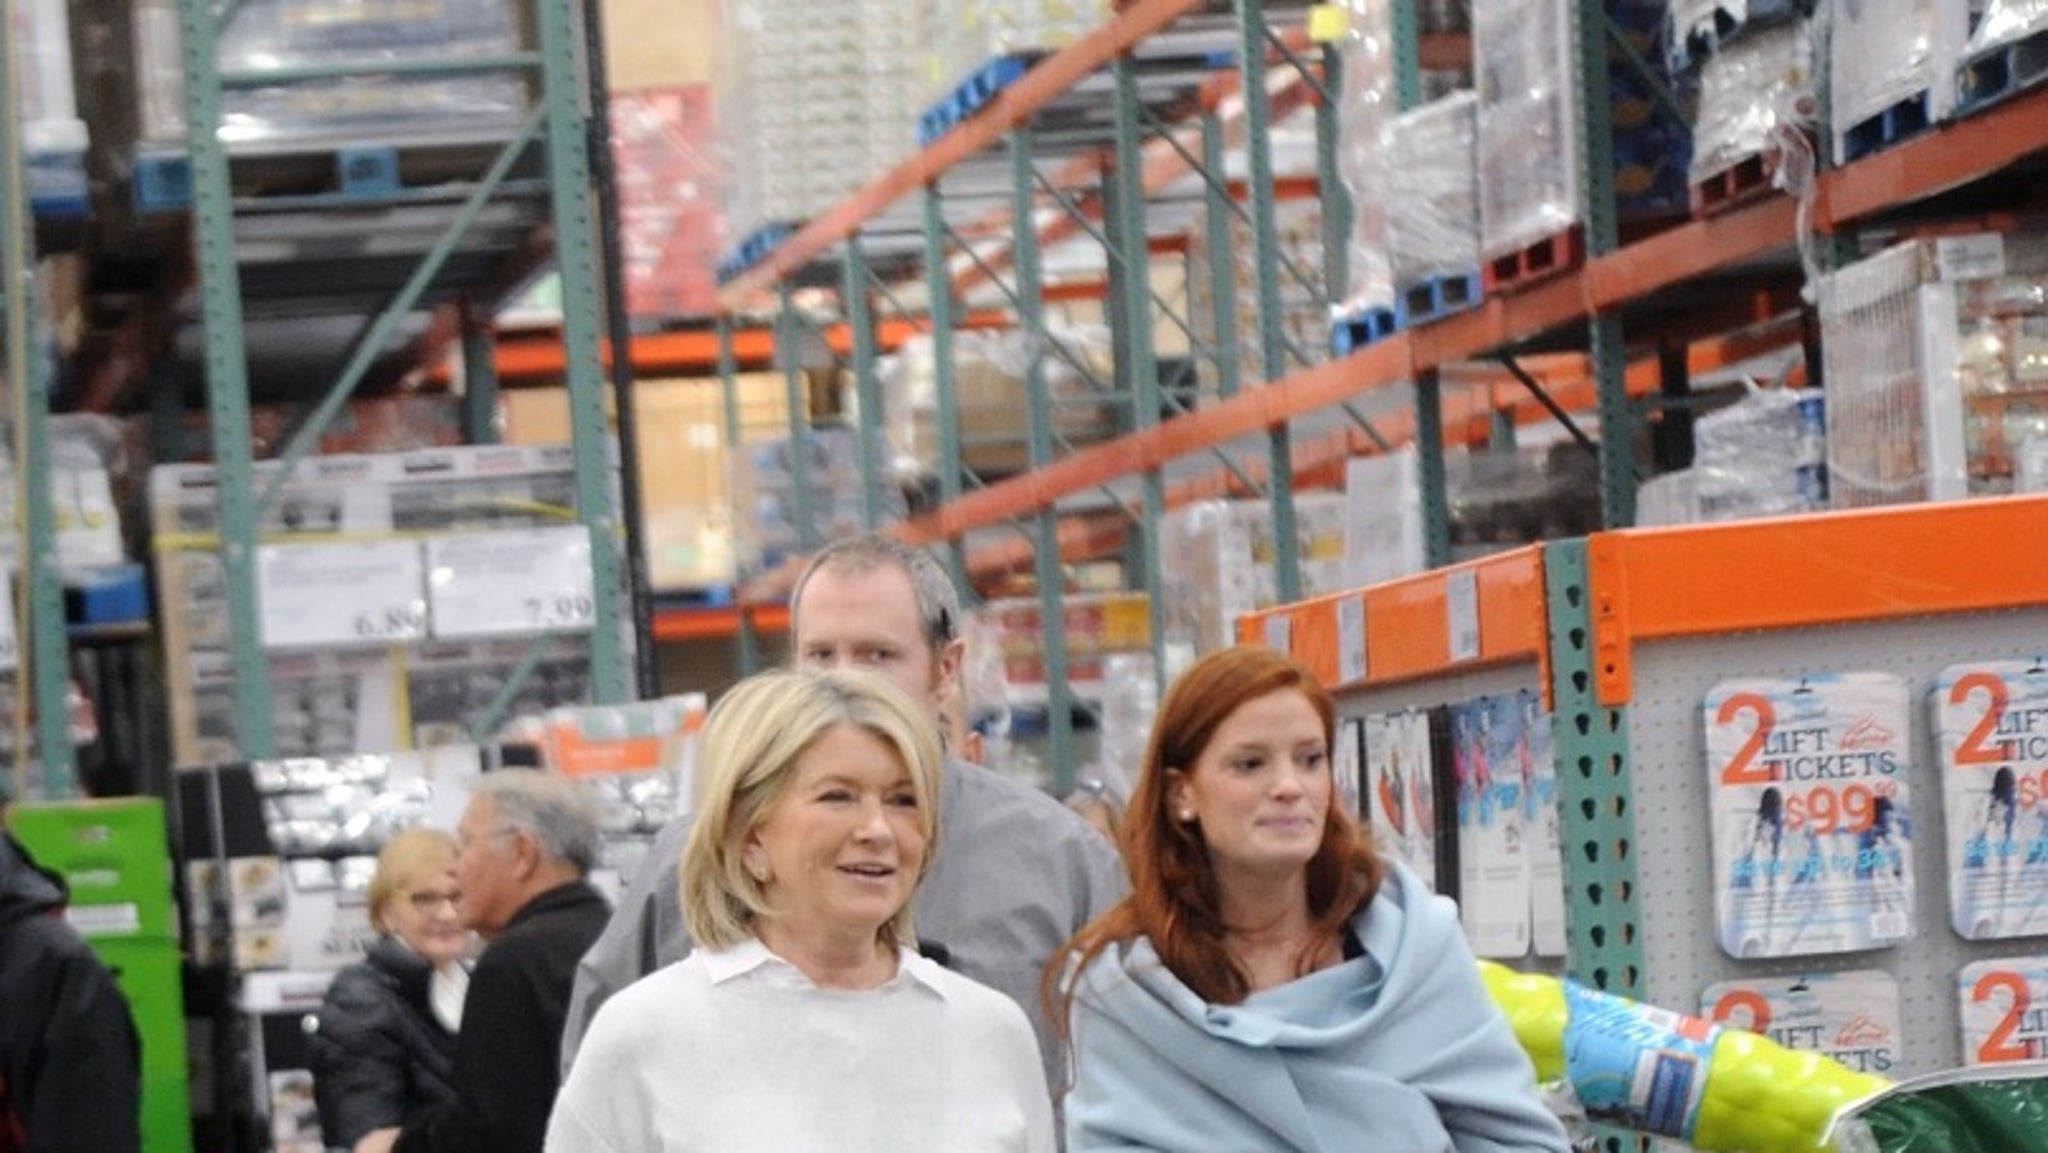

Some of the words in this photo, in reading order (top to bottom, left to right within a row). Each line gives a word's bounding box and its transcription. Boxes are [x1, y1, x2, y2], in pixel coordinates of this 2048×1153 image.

[1950, 671, 2014, 765] 2
[1995, 708, 2048, 735] LIF
[1717, 692, 1784, 785] 2
[1762, 728, 1829, 756] LIFT
[1763, 751, 1897, 782] TICKETS
[1973, 972, 2033, 1063] 2
[1768, 1025, 1825, 1050] IFT
